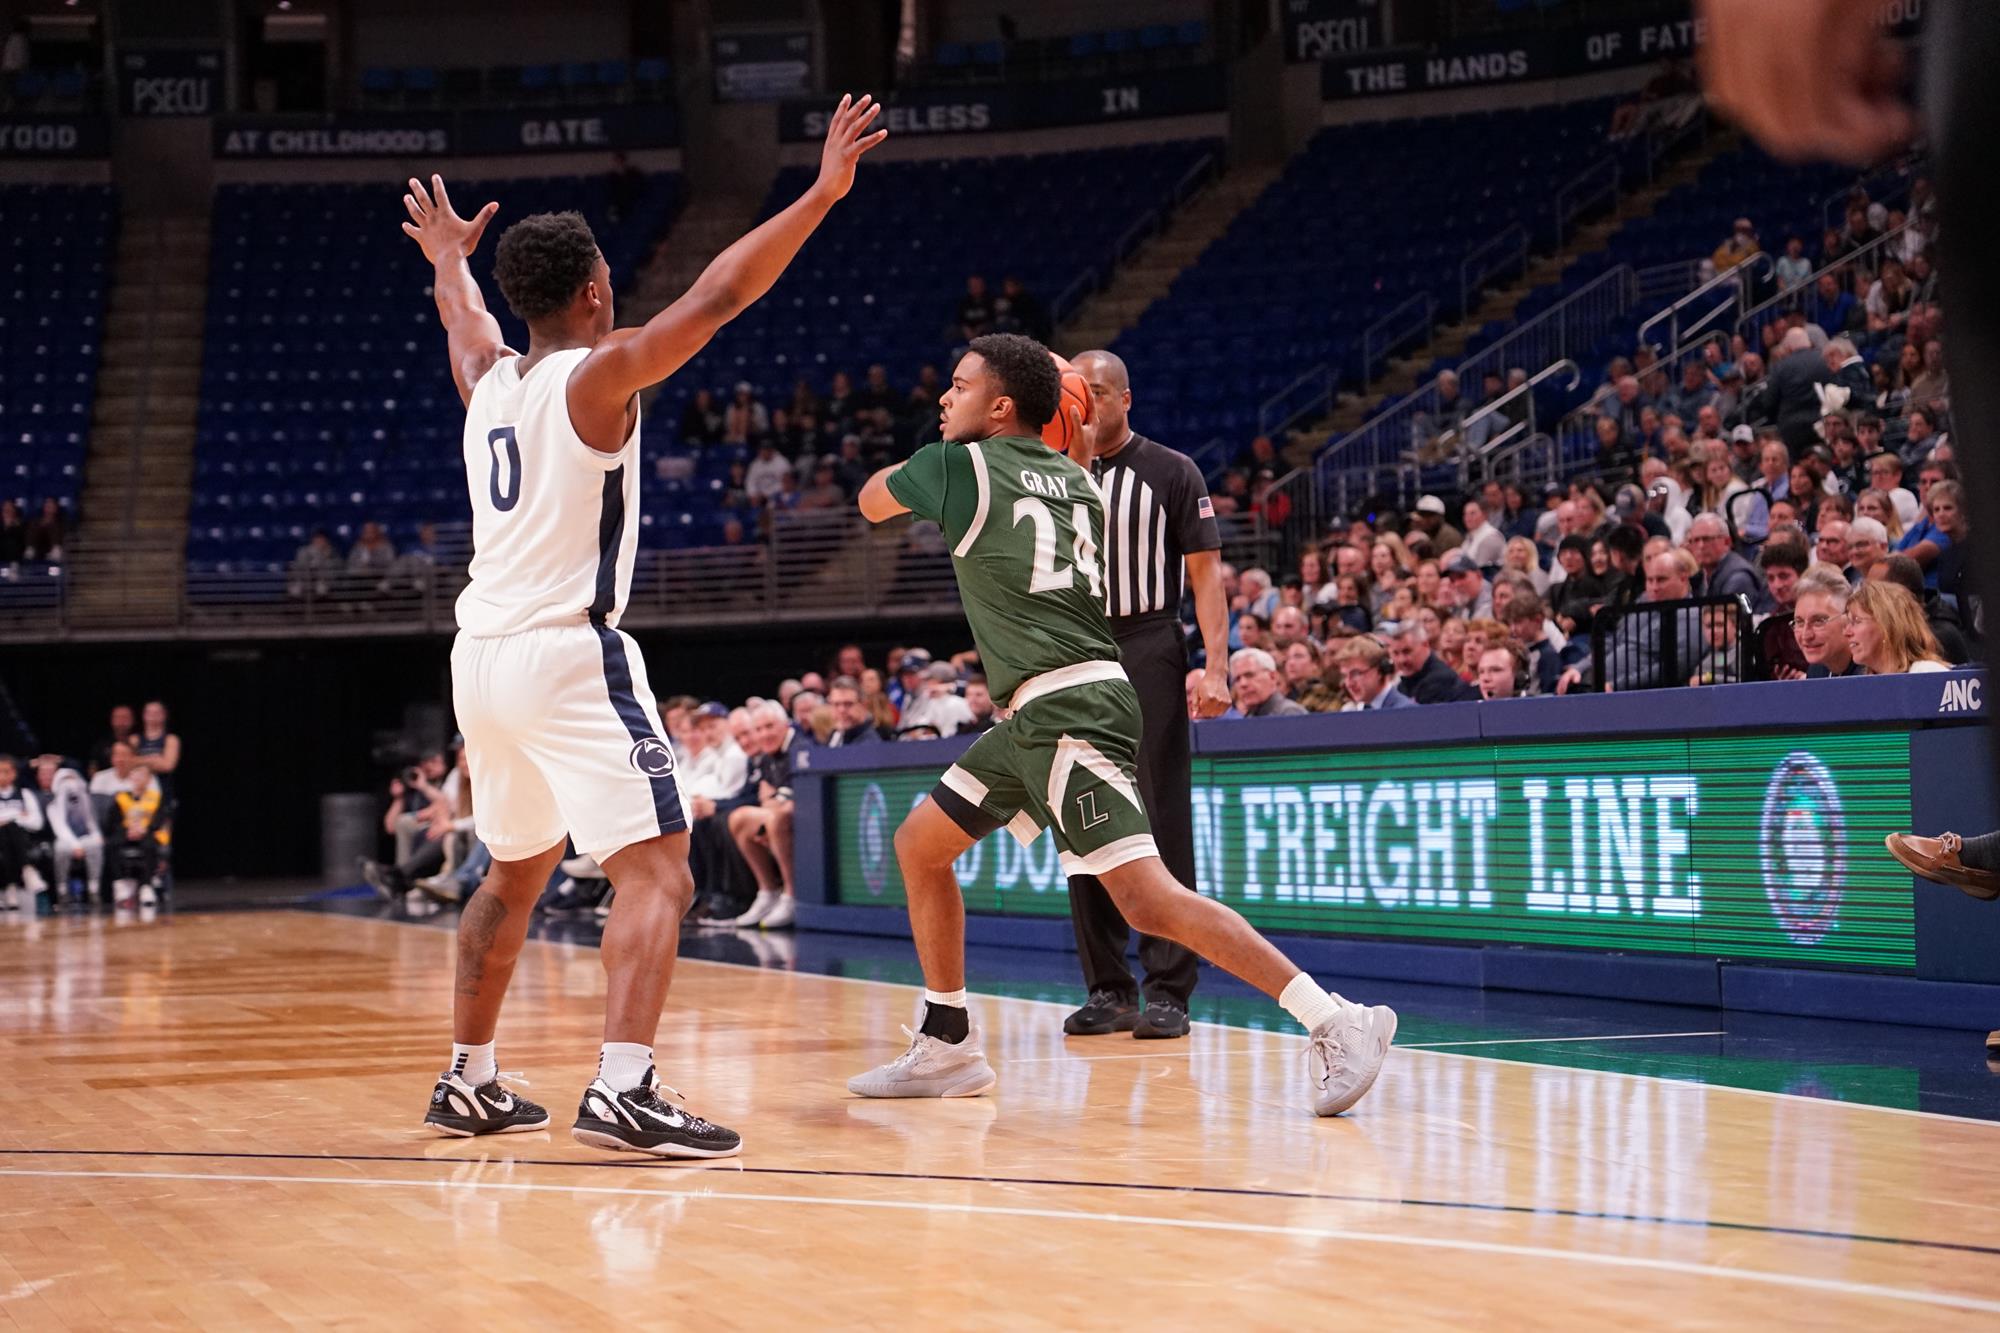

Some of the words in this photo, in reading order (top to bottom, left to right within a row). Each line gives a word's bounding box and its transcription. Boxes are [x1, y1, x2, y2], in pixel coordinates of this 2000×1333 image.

[1297, 17, 1368, 58] PSECU
[1345, 63, 1407, 93] THE
[1425, 50, 1528, 85] HANDS
[1586, 33, 1622, 61] OF
[132, 77, 209, 114] PSECU
[803, 103, 990, 137] SELESS
[1101, 87, 1140, 114] IN
[224, 129, 261, 153] AT
[268, 129, 447, 153] CHILDHOODS
[488, 426, 522, 512] 0
[1020, 470, 1069, 498] GRAY
[1013, 496, 1103, 597] 24
[1939, 678, 1981, 712] ANC
[1241, 780, 1496, 908] FREIGHT
[1523, 776, 1701, 917] LINE
